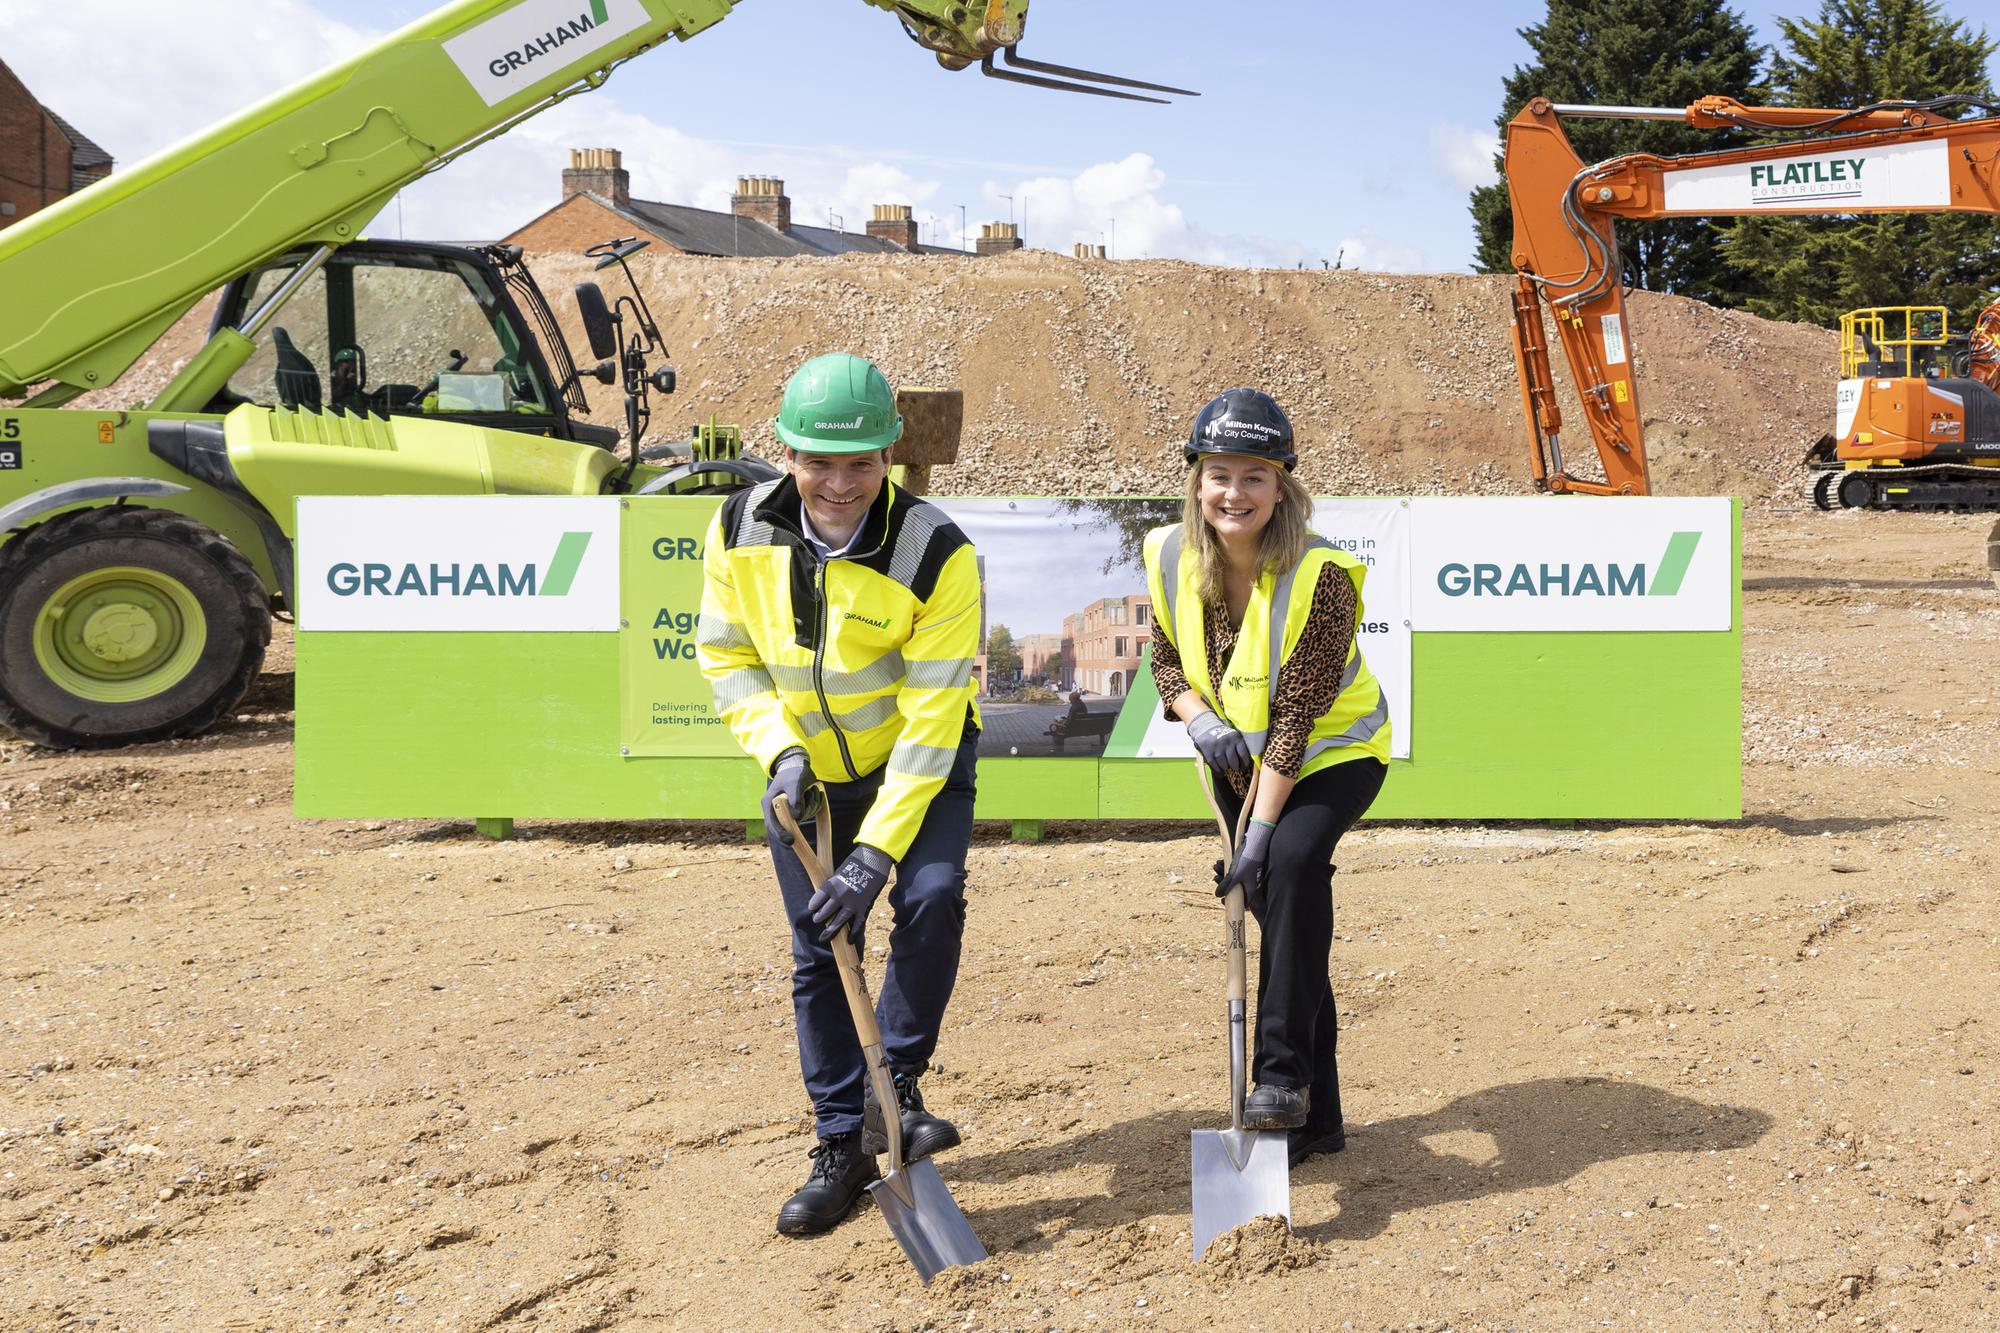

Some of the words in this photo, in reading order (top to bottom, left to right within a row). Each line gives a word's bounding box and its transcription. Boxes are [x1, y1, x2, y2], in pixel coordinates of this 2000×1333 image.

[489, 14, 595, 77] GRAHAM
[1750, 158, 1866, 187] FLATLEY
[1751, 182, 1862, 197] CONSTRUCTION
[0, 418, 20, 439] 5
[1224, 429, 1240, 438] City
[1241, 431, 1269, 441] Council
[1225, 421, 1253, 430] Milton
[1254, 423, 1281, 437] Keynes
[652, 537, 705, 561] GR
[1362, 537, 1376, 549] in
[327, 562, 536, 597] GRAHAM
[1437, 563, 1645, 597] GRAHAM
[844, 612, 882, 628] GRAHAM
[653, 702, 707, 713] Delivering
[653, 715, 690, 726] lasting
